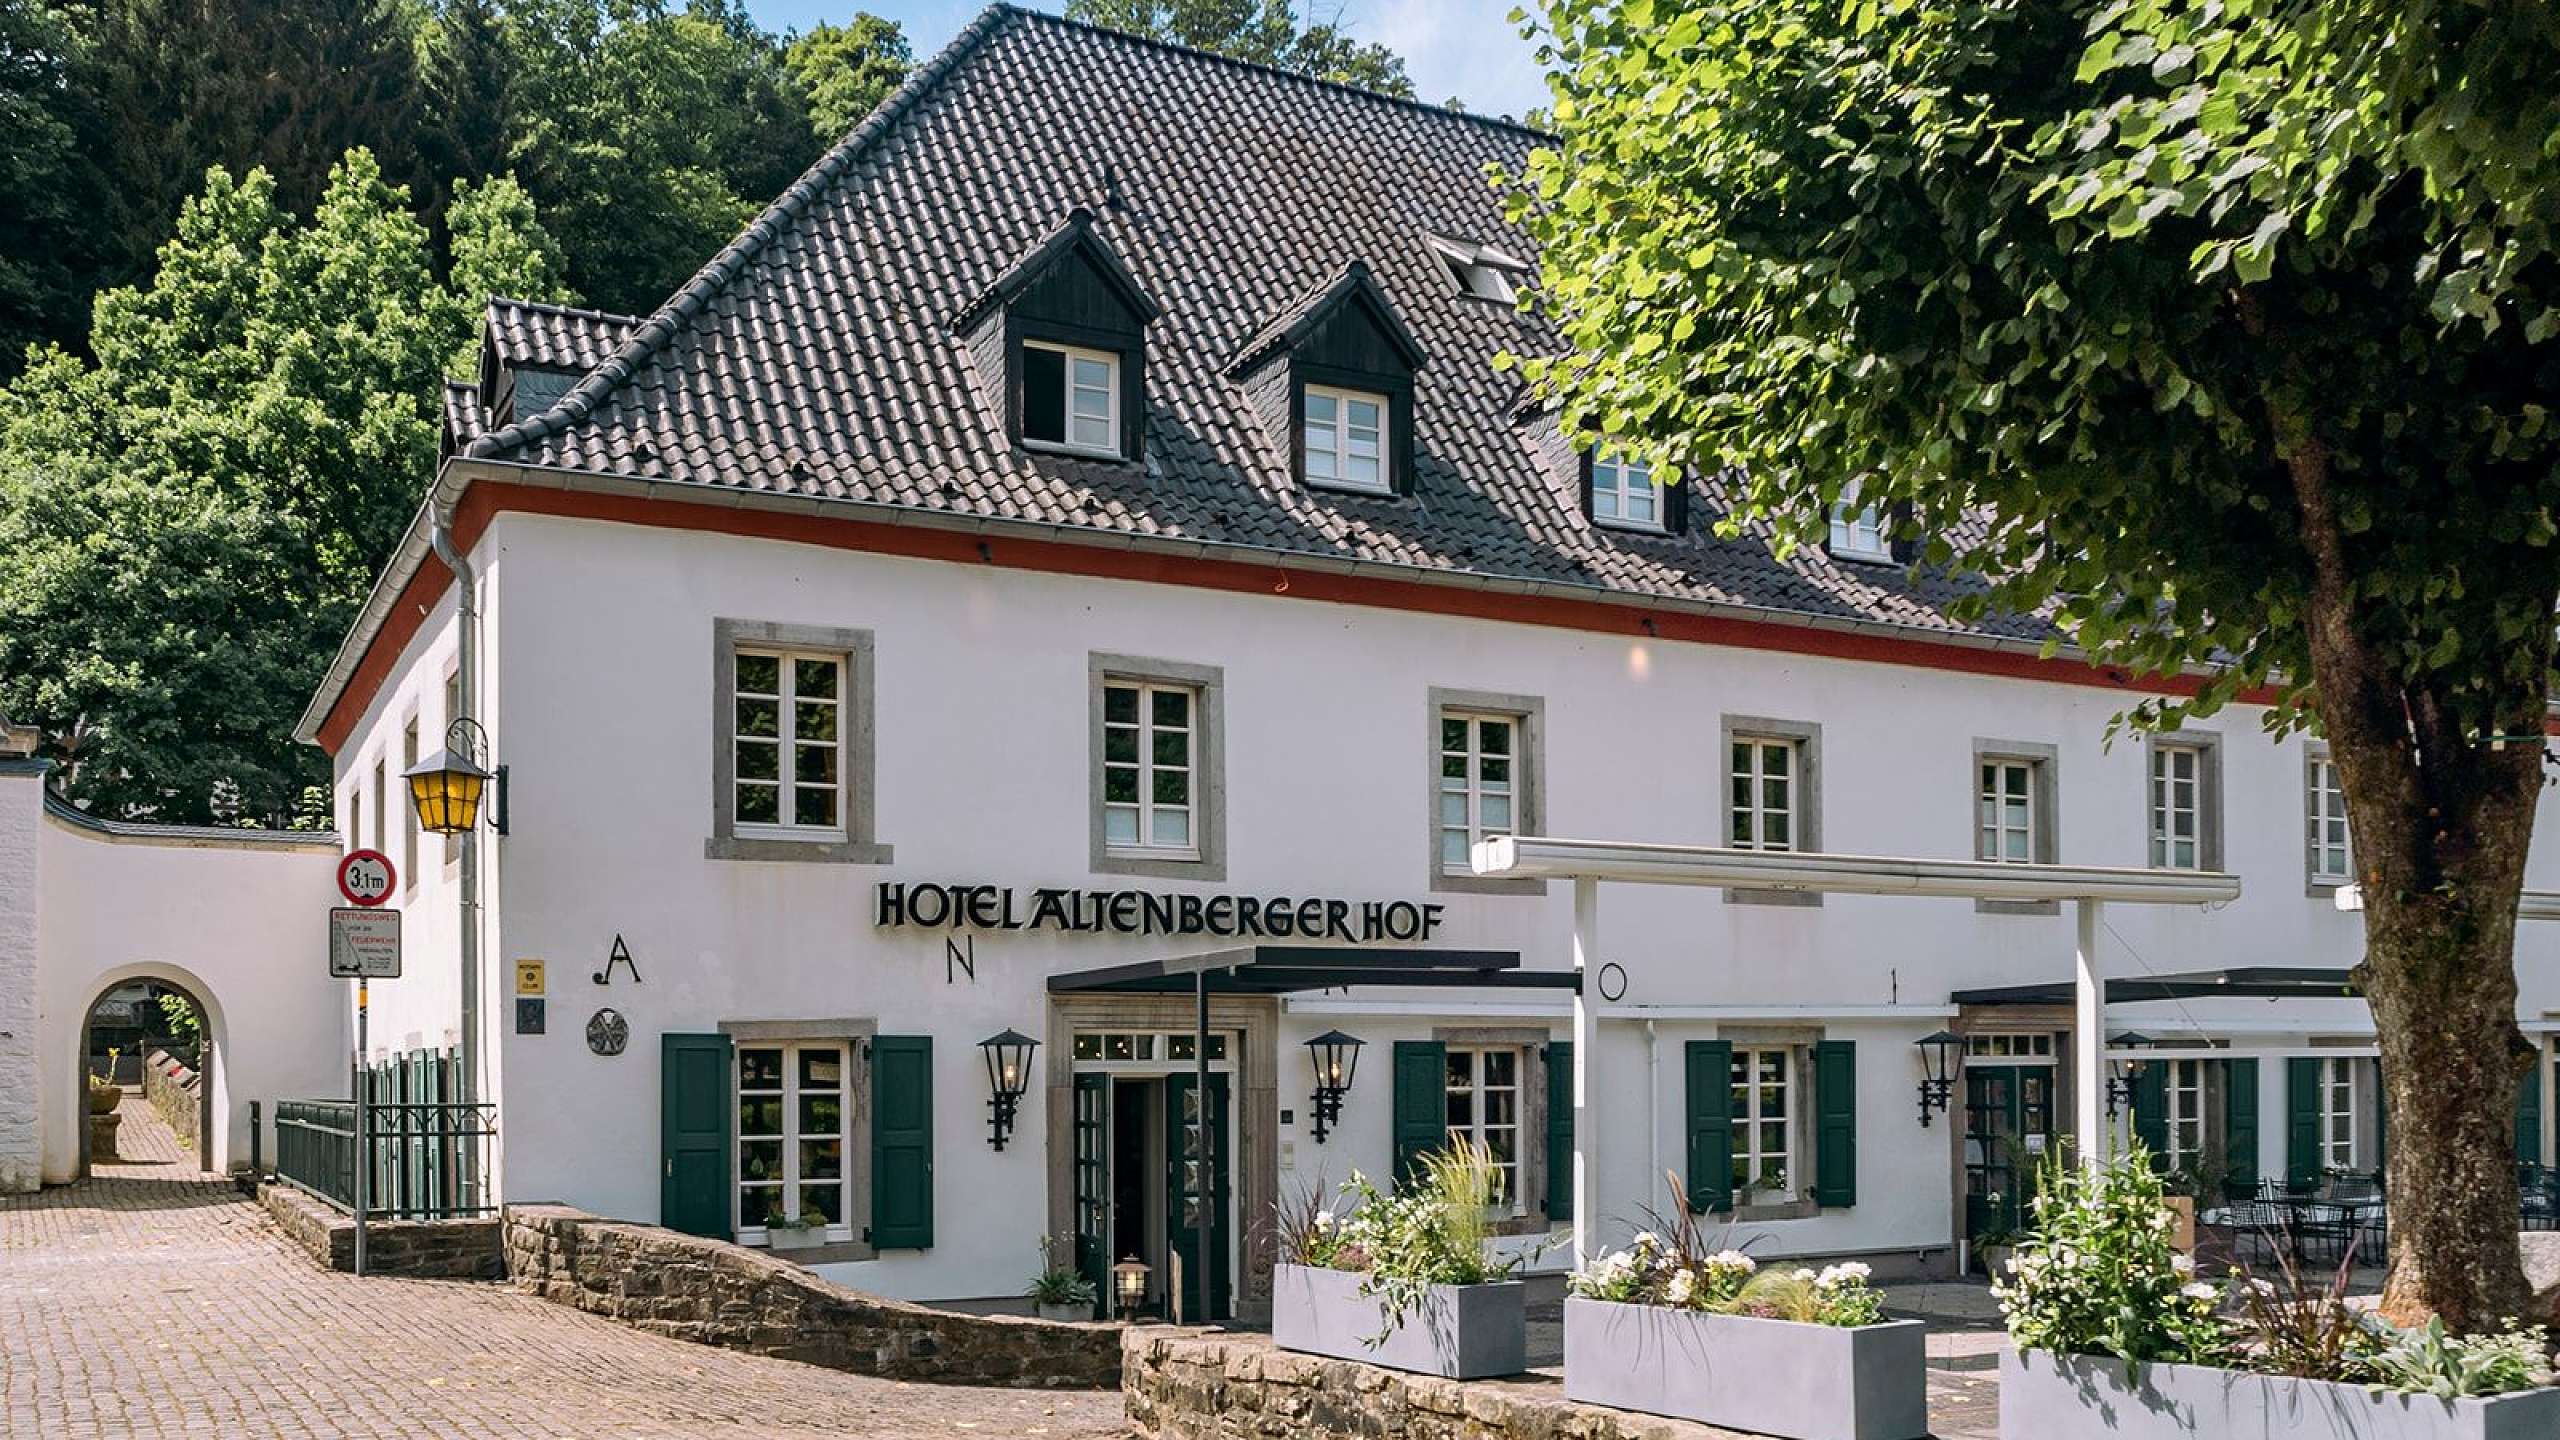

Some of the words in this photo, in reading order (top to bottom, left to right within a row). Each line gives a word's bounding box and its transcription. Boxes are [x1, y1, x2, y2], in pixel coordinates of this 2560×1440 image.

[878, 882, 1023, 929] HOTEL
[1028, 887, 1358, 944] ALTENBERGER
[1362, 900, 1445, 941] HOF
